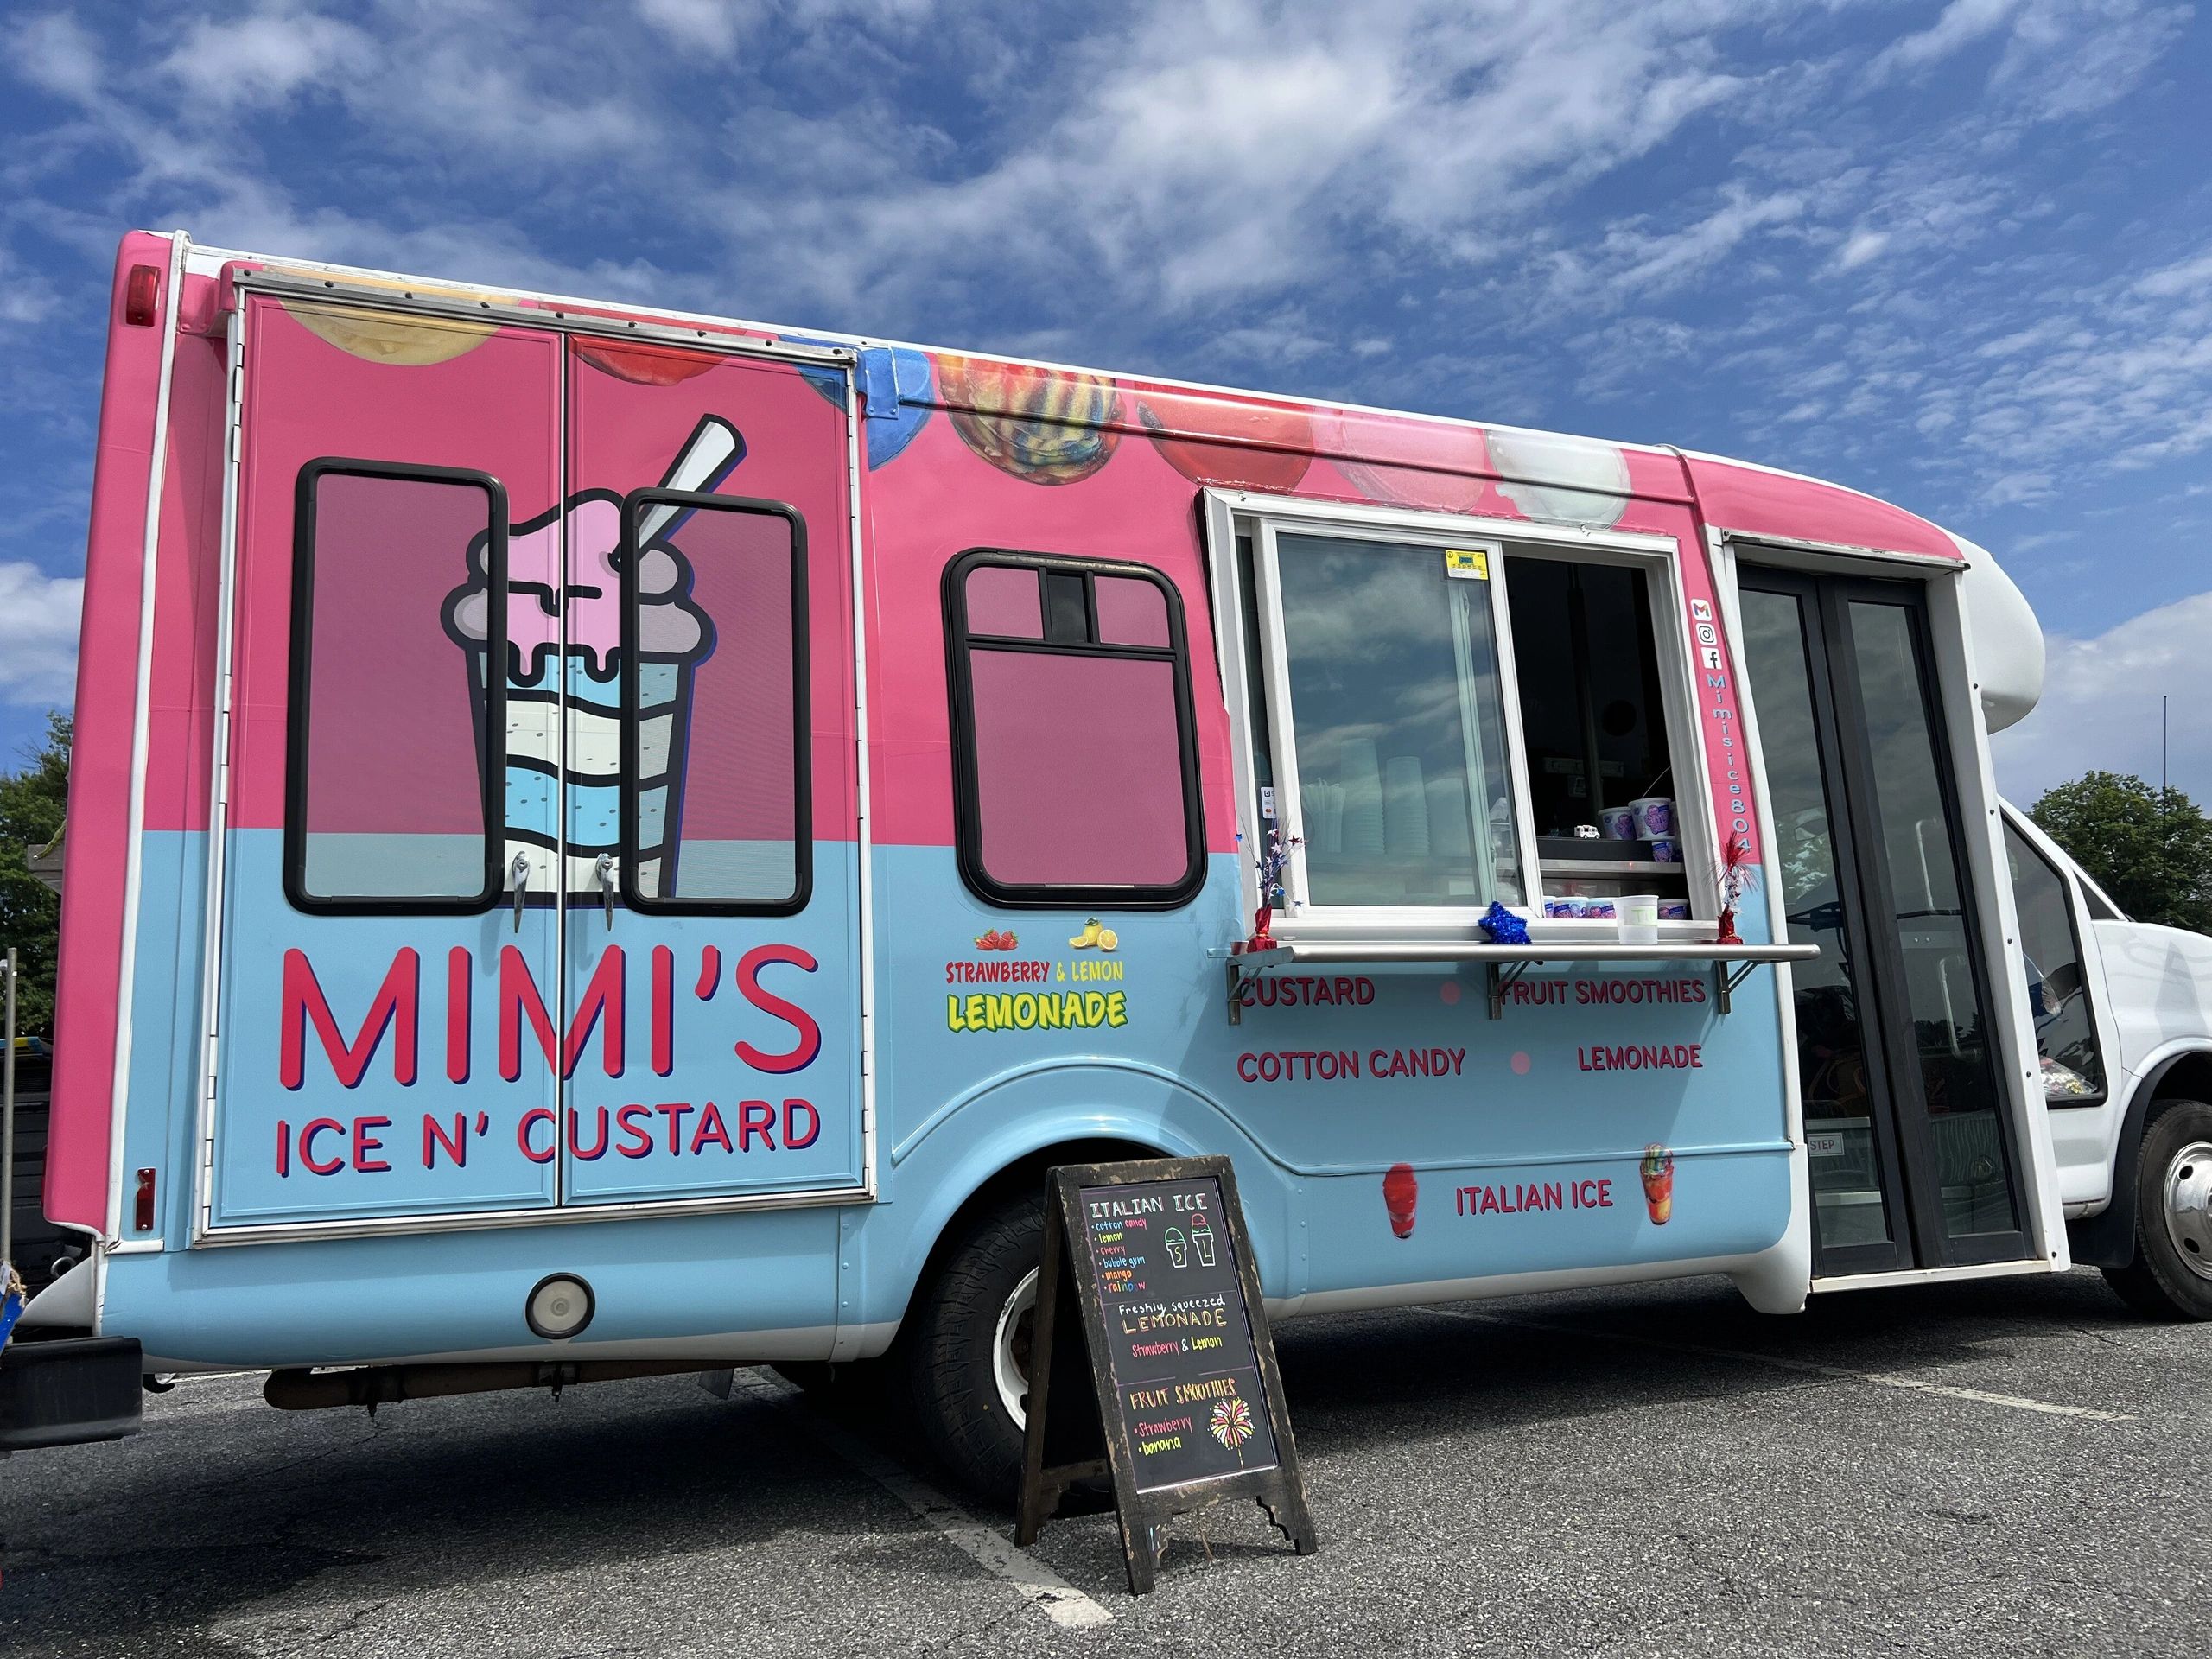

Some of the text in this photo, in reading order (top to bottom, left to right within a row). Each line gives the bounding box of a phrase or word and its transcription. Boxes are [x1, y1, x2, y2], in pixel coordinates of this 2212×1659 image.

[946, 961, 1124, 983] STRAWBERRY & LEMON
[1239, 977, 1376, 1007] CUSTARD
[1575, 980, 1707, 1004] SMOOTHIES
[280, 944, 821, 1090] MIMI'S
[947, 990, 1128, 1033] LEMONADE
[1236, 1048, 1466, 1083] COTTON CANDY
[1578, 1044, 1704, 1071] LEMONADE
[276, 1098, 821, 1178] ICE N' CUSTARD
[1810, 1140, 1834, 1151] STEP
[1090, 1192, 1208, 1218] ITALIAN ICE
[1456, 1179, 1614, 1216] ITALIAN ICE
[1096, 1217, 1147, 1231] cotton candy
[1098, 1232, 1123, 1243] lemon
[1202, 1239, 1211, 1258] L
[1103, 1255, 1146, 1269] bubble gum
[1174, 1246, 1182, 1262] S
[1105, 1269, 1133, 1282] mango
[1108, 1280, 1147, 1294] rainbow
[1119, 1294, 1226, 1318] Freshly squeezed
[1122, 1308, 1228, 1335] LEMONADE
[1181, 1338, 1189, 1352] &
[1191, 1335, 1223, 1351] Lemon
[1129, 1376, 1236, 1410] FRUIT SMOOTHIES
[1141, 1435, 1182, 1457] banana
